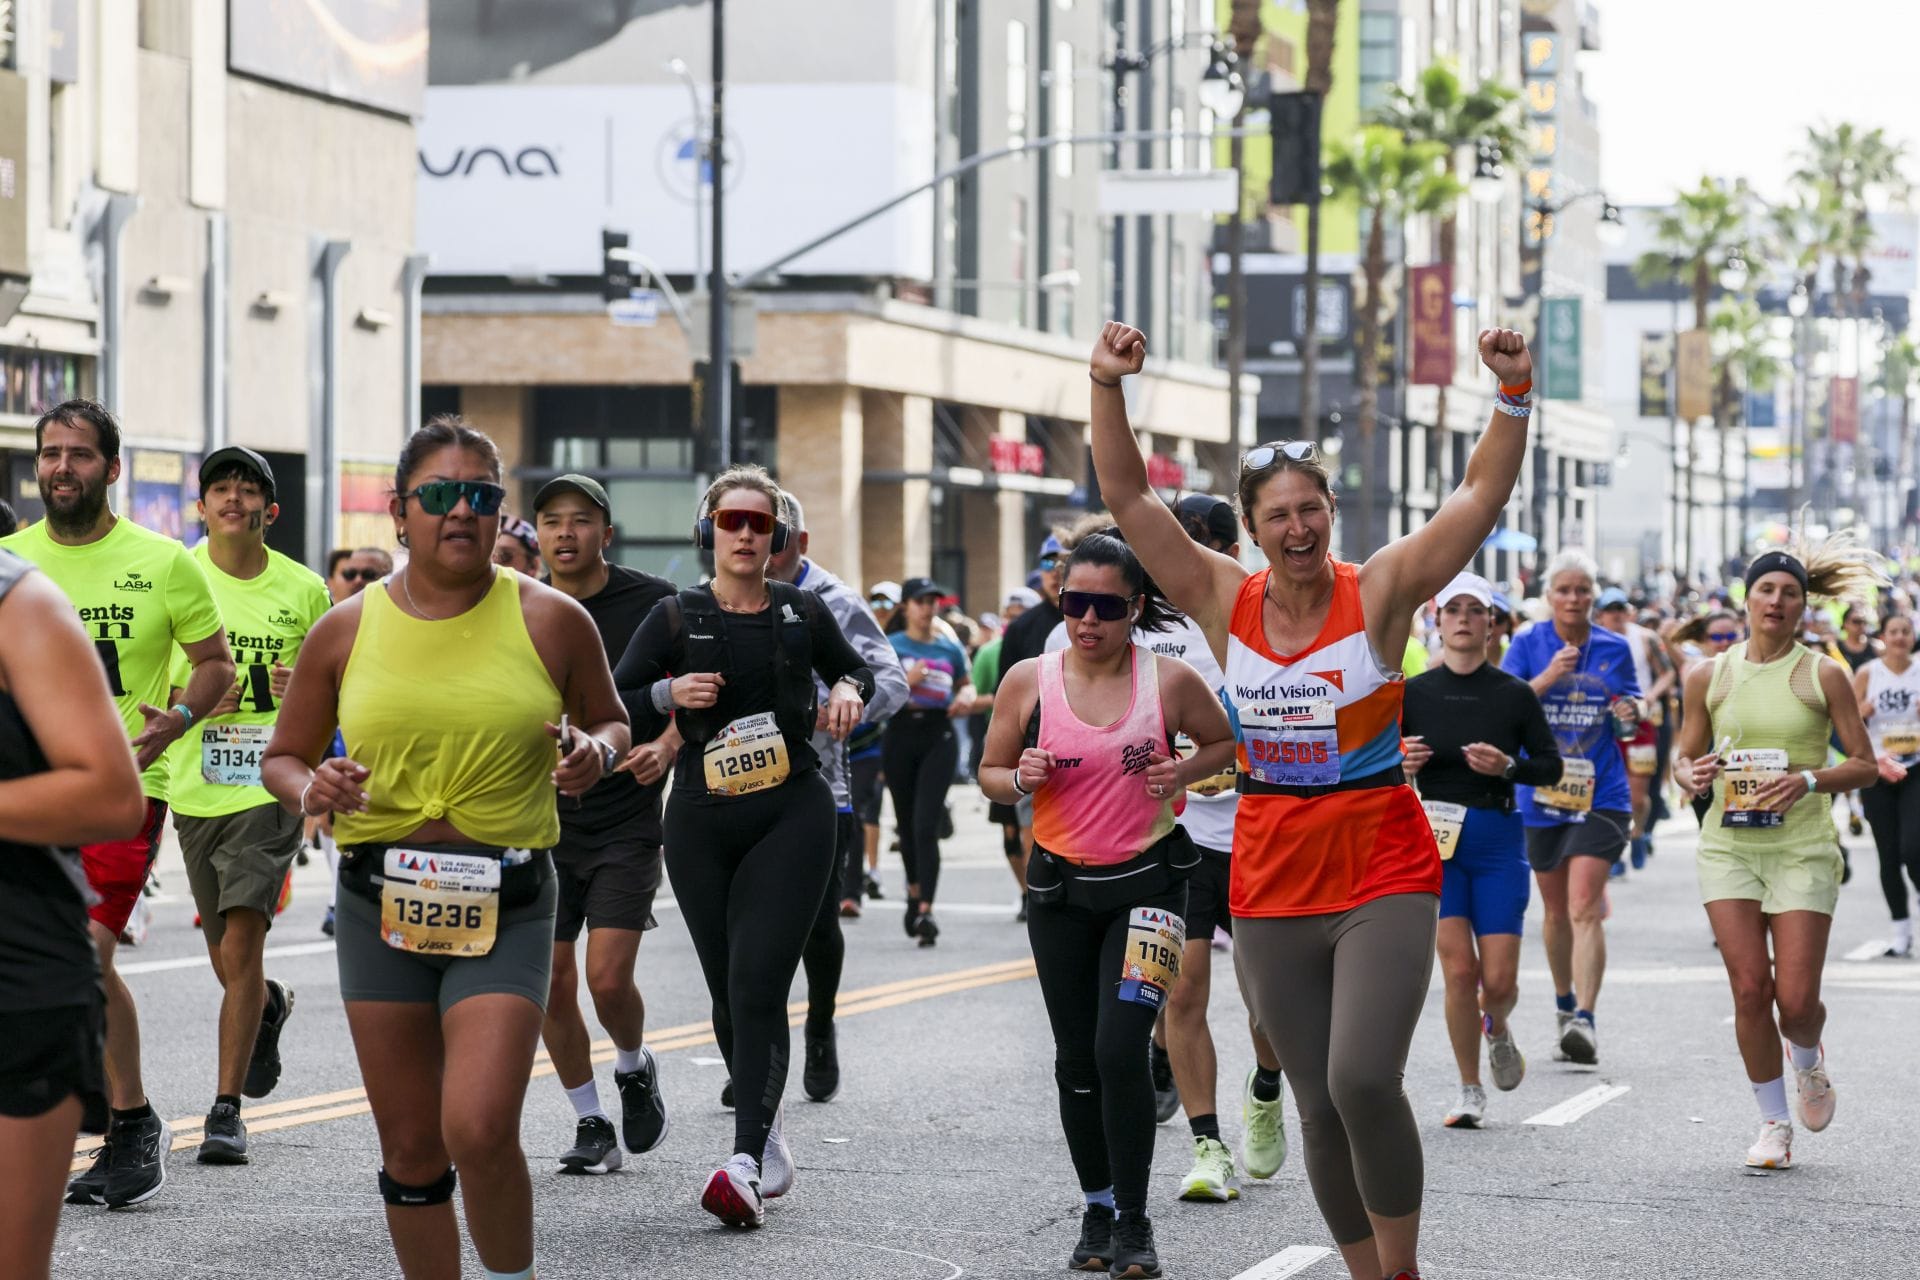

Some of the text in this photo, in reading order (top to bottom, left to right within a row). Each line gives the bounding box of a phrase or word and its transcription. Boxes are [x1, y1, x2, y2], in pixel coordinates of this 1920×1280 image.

[113, 580, 153, 590] LA84
[78, 603, 135, 622] ents
[268, 615, 298, 626] LA84
[1236, 683, 1328, 700] World Vision
[1267, 705, 1312, 716] CHARITY
[737, 721, 770, 731] MARATHON
[727, 737, 741, 749] 40
[1121, 739, 1156, 765] Party
[1252, 739, 1329, 765] 90505
[714, 746, 778, 778] 12891
[747, 779, 766, 790] asics
[1731, 780, 1758, 796] 193
[440, 866, 486, 876] MARATHON
[419, 878, 438, 891] 40
[394, 897, 483, 930] 13236
[1157, 928, 1170, 940] 40
[428, 942, 454, 951] asics
